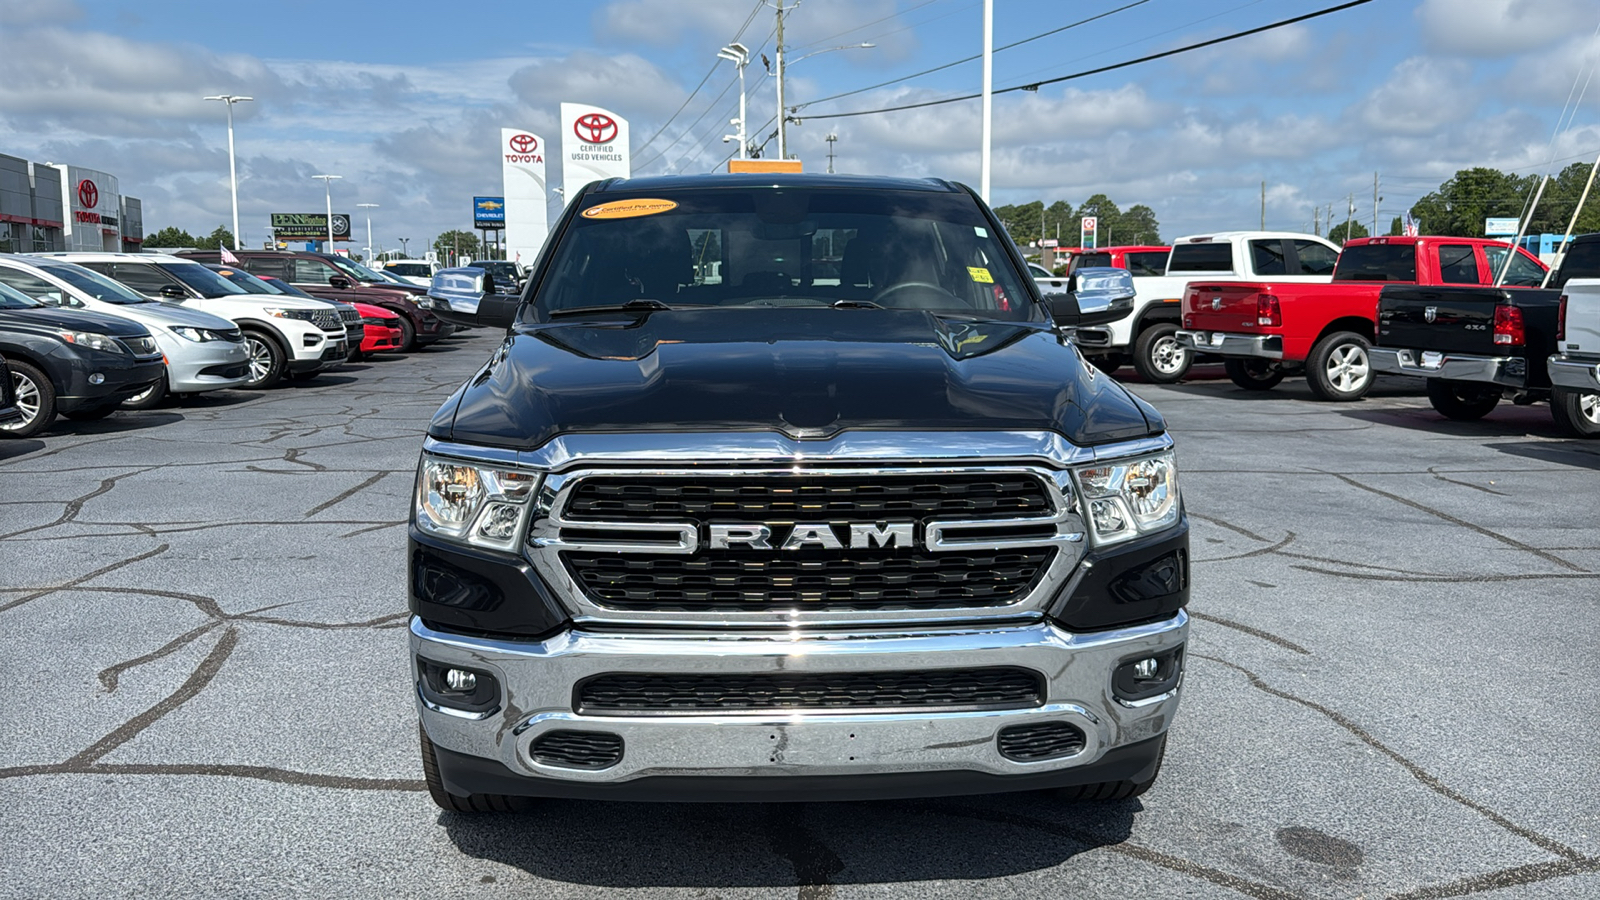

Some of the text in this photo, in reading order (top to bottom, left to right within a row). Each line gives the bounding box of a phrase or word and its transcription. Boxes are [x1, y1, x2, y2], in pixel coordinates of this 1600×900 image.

[505, 155, 543, 163] TOYOTA
[571, 153, 623, 162] USED VEHICLES
[74, 211, 101, 224] TOYOTA
[709, 523, 914, 549] RAM
